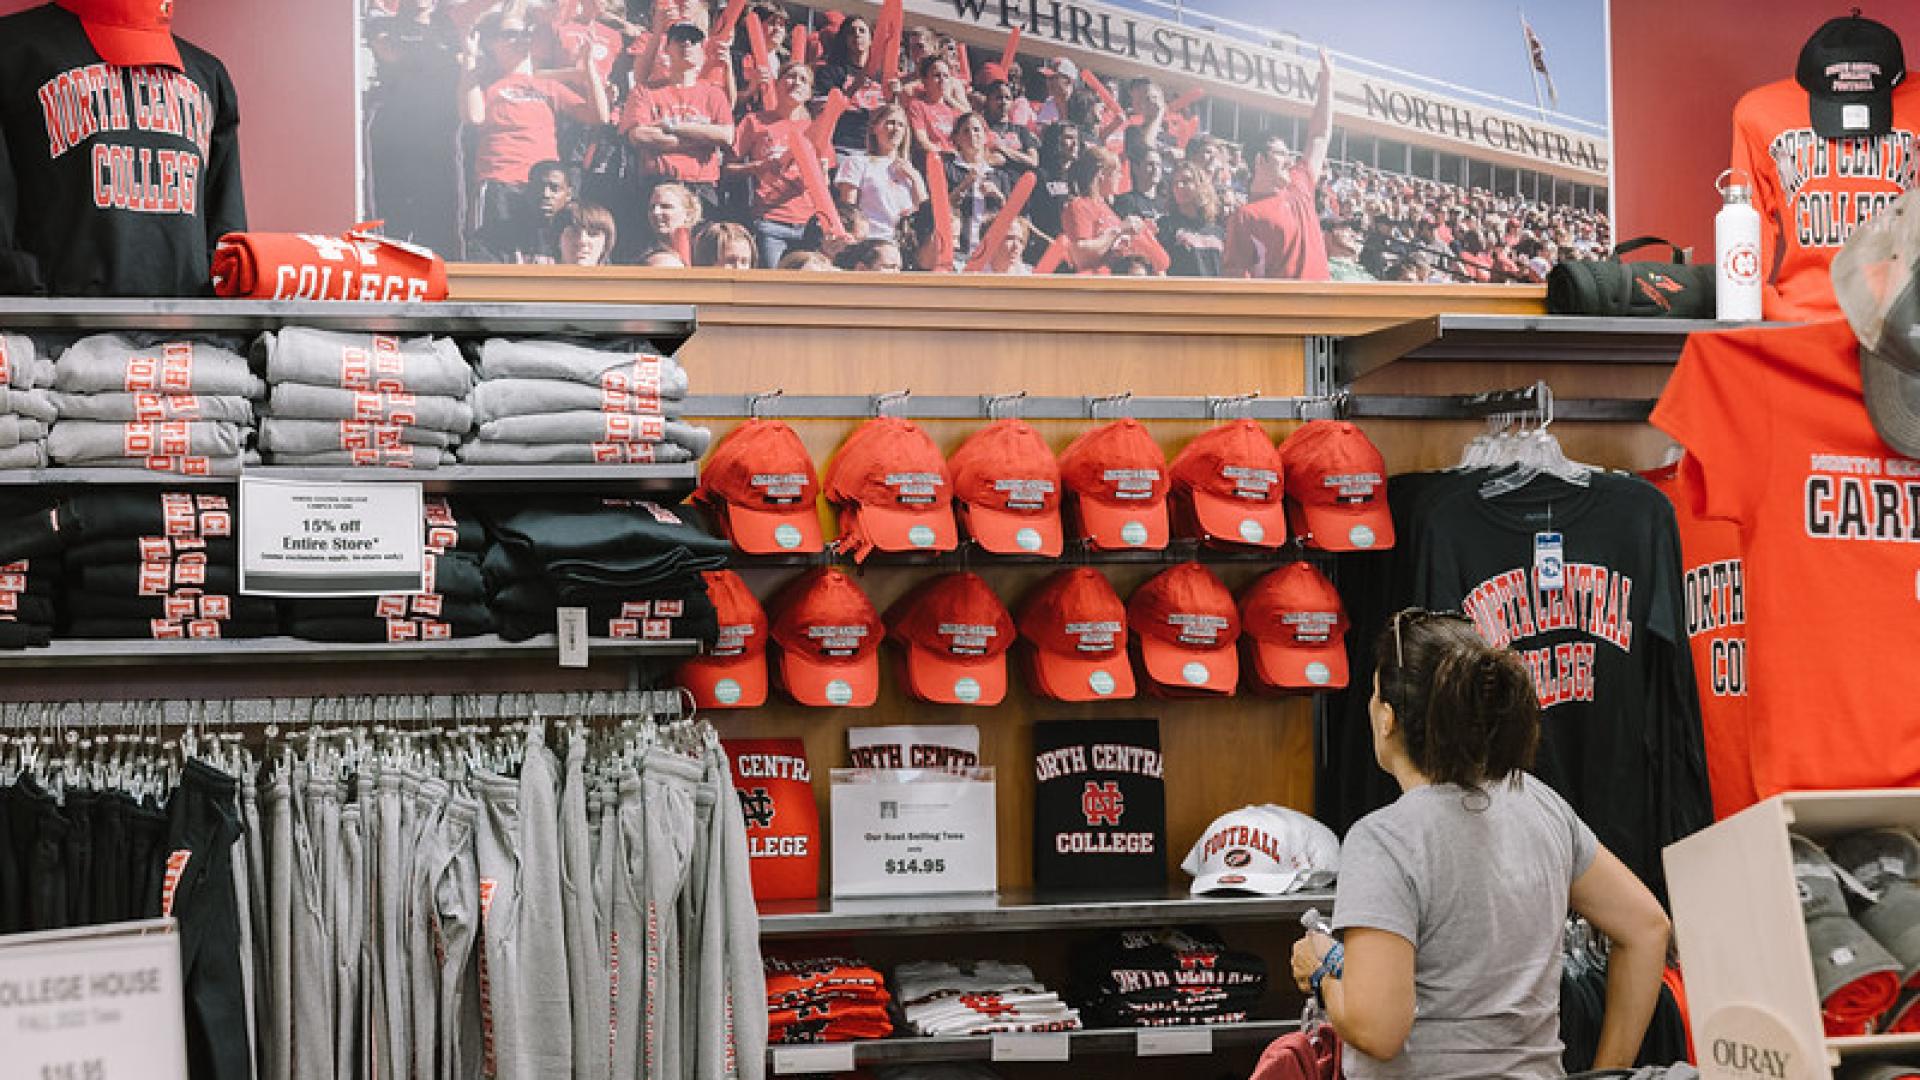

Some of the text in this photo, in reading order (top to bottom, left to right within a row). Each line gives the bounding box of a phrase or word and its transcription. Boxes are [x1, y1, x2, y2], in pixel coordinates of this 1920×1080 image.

[951, 0, 1322, 102] WEHRLI STADIUM
[38, 64, 130, 160] NORTH
[1362, 81, 1606, 171] NORTH CENTRAL
[281, 535, 329, 551] Entire
[302, 518, 361, 533] 15% off
[1685, 559, 1746, 638] ORTH
[749, 835, 808, 858] LEGE
[1055, 832, 1154, 854] COLLEGE
[1203, 825, 1281, 865] FOOTBALL
[884, 858, 946, 875] $14.95
[90, 966, 162, 996] HOUSE
[1713, 1038, 1791, 1079] OURAY
